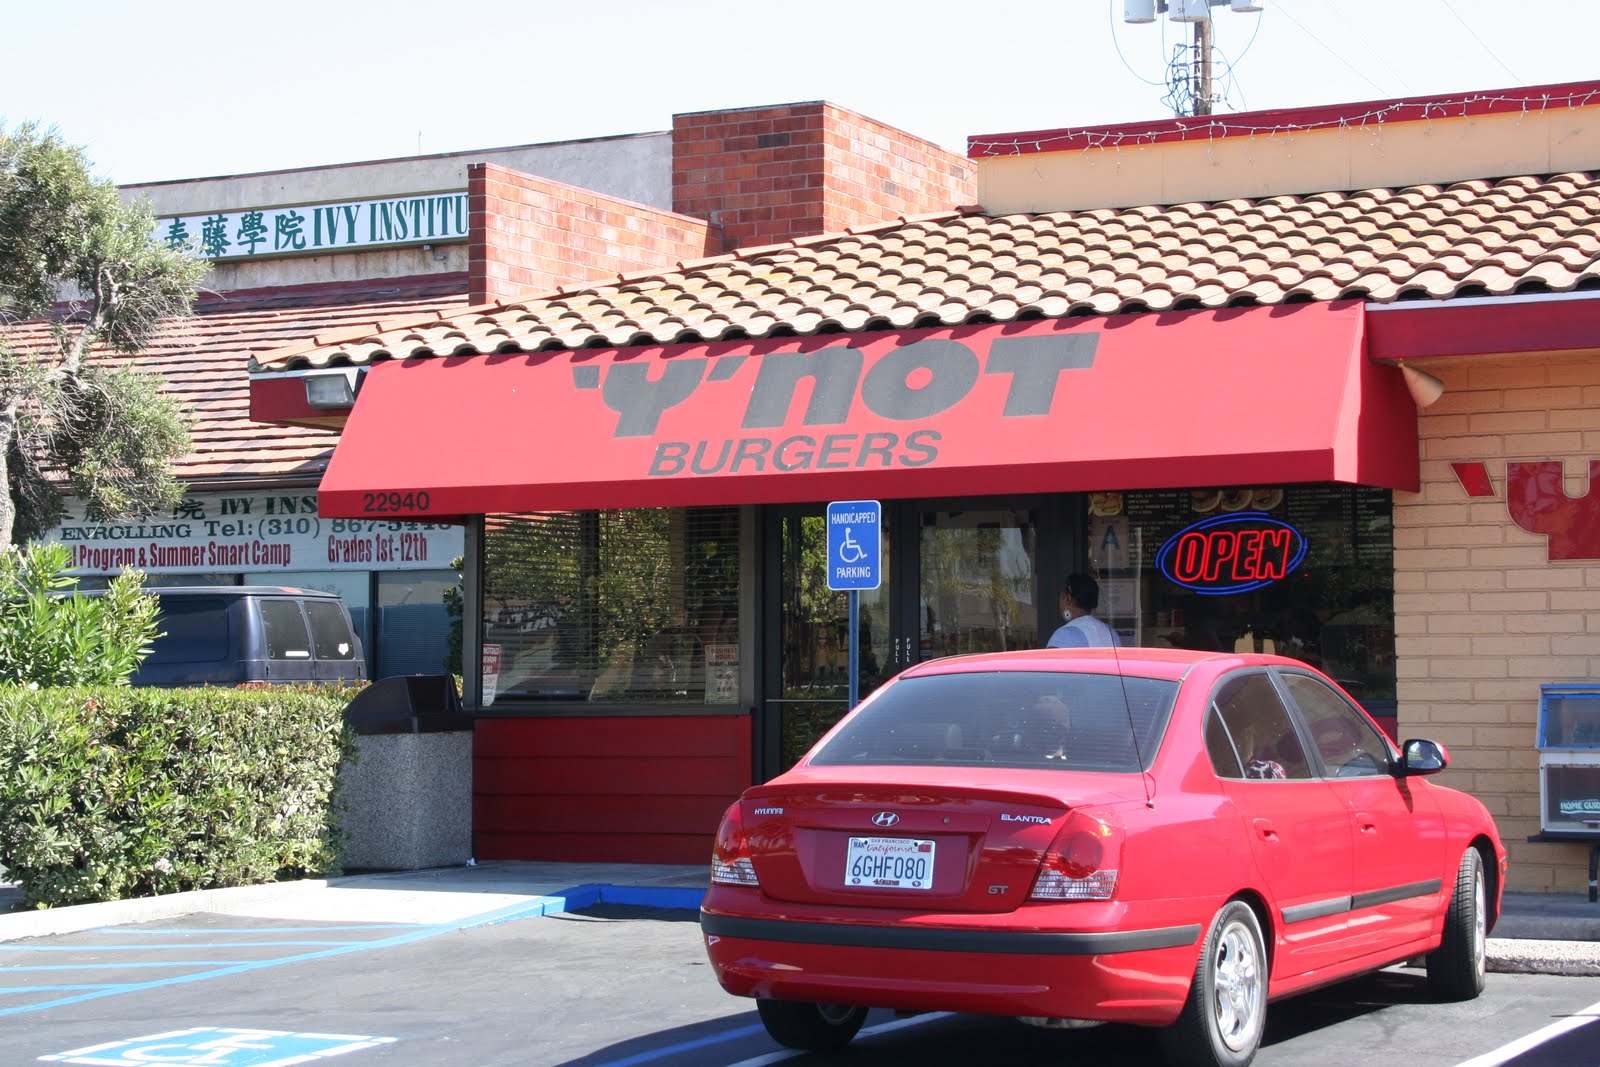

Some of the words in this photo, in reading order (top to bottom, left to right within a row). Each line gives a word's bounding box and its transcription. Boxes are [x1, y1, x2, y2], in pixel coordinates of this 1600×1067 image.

[312, 204, 362, 247] IVY
[368, 194, 470, 242] INSTITU
[647, 430, 943, 477] BURGERS
[220, 496, 254, 515] IVY
[363, 491, 431, 512] 22940
[831, 511, 876, 525] HANDICAPPED
[60, 523, 192, 541] ENROLLING
[1101, 524, 1120, 551] A
[79, 544, 136, 571] Program
[139, 546, 147, 567] &
[150, 542, 206, 567] Summer
[208, 540, 250, 566] Smart
[252, 539, 292, 567] Camp
[327, 534, 373, 563] Grades
[1174, 529, 1292, 583] OPEN
[836, 566, 871, 579] PARKING
[1560, 801, 1583, 810] HOME
[1001, 813, 1052, 825] ELANTRA
[866, 844, 913, 855] California
[852, 855, 926, 880] 6GHF080
[987, 885, 1009, 895] GT
